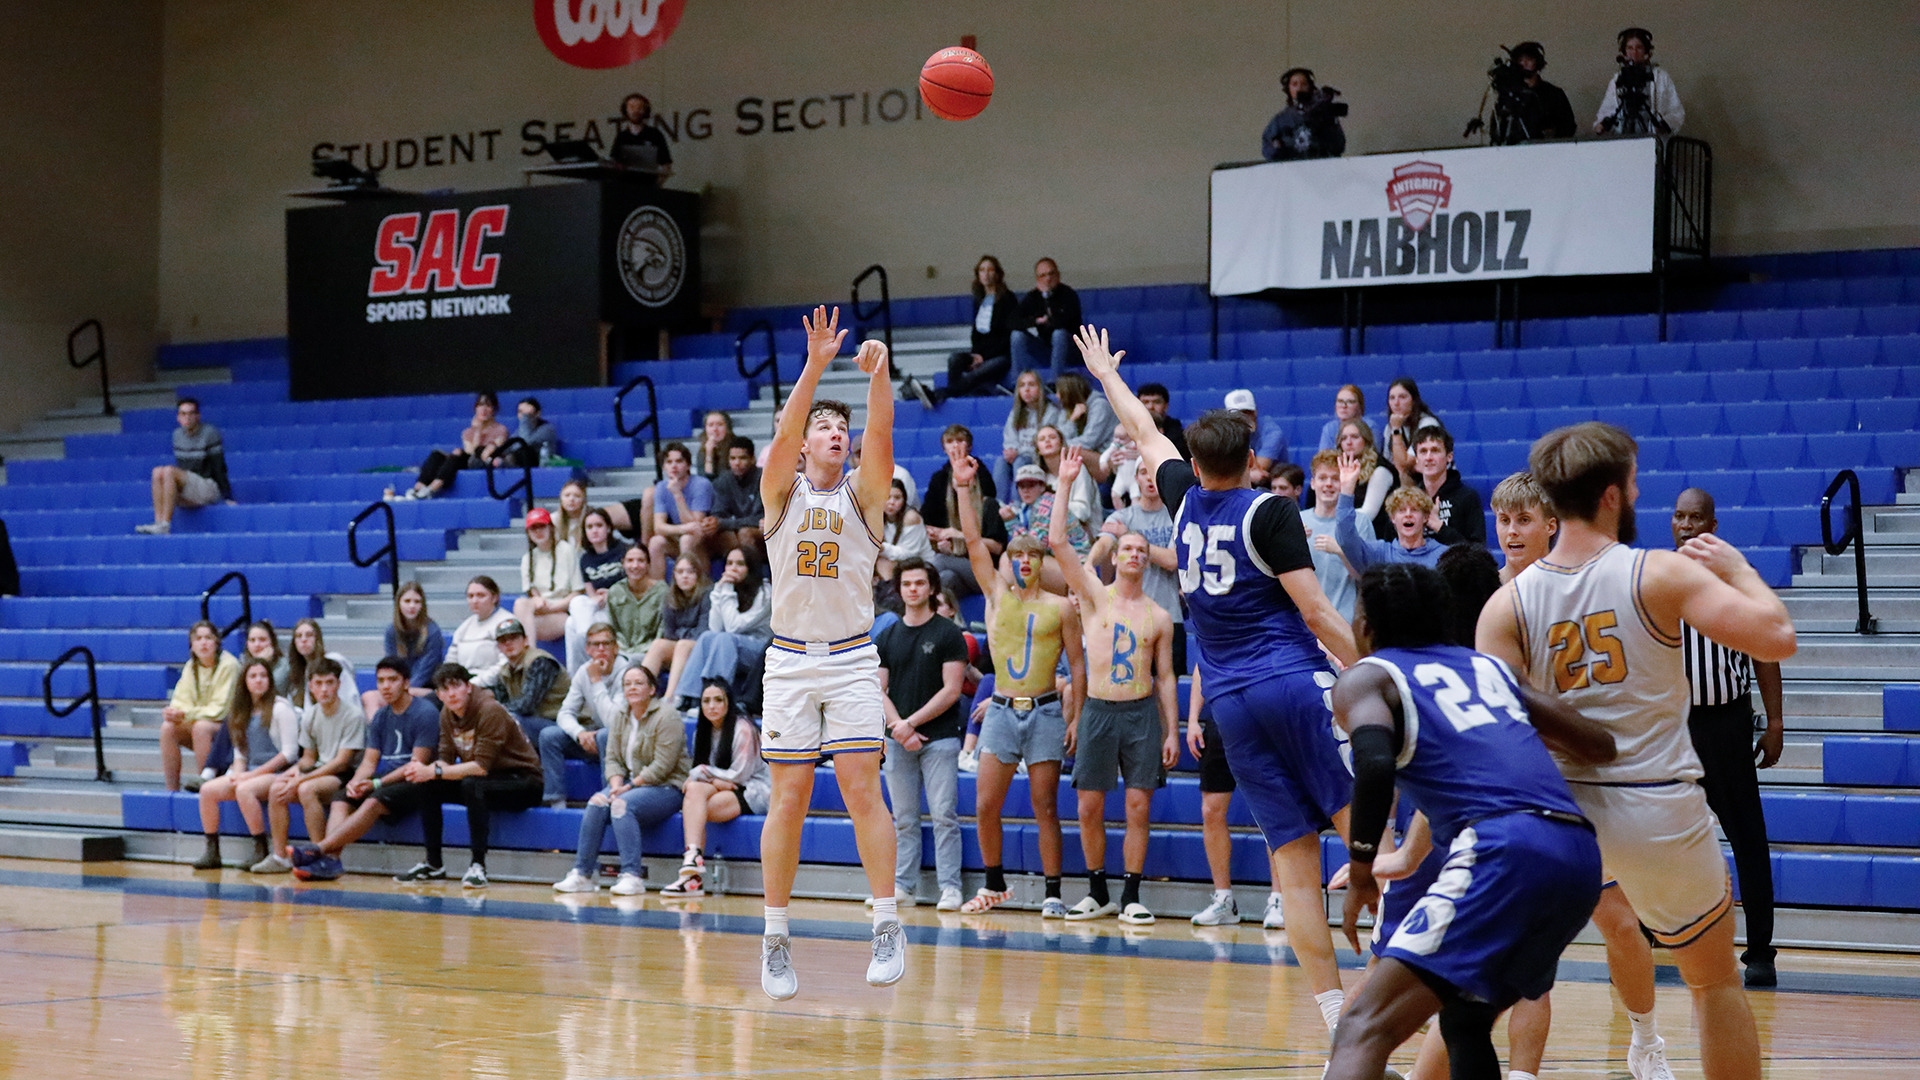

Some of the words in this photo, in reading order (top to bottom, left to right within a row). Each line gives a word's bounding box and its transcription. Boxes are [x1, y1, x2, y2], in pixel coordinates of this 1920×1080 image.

[521, 109, 713, 156] SEATNG
[1392, 177, 1446, 194] INTEGRITY
[368, 204, 510, 298] SAC
[1320, 209, 1532, 280] NABHOLZ
[366, 300, 427, 323] SPORTS
[431, 294, 511, 318] NETWORK
[797, 507, 843, 535] JBU
[797, 540, 839, 579] 22
[1178, 521, 1236, 596] 35
[1007, 613, 1035, 680] J
[1110, 622, 1137, 685] B
[1546, 609, 1628, 693] 25
[1413, 656, 1532, 732] 24
